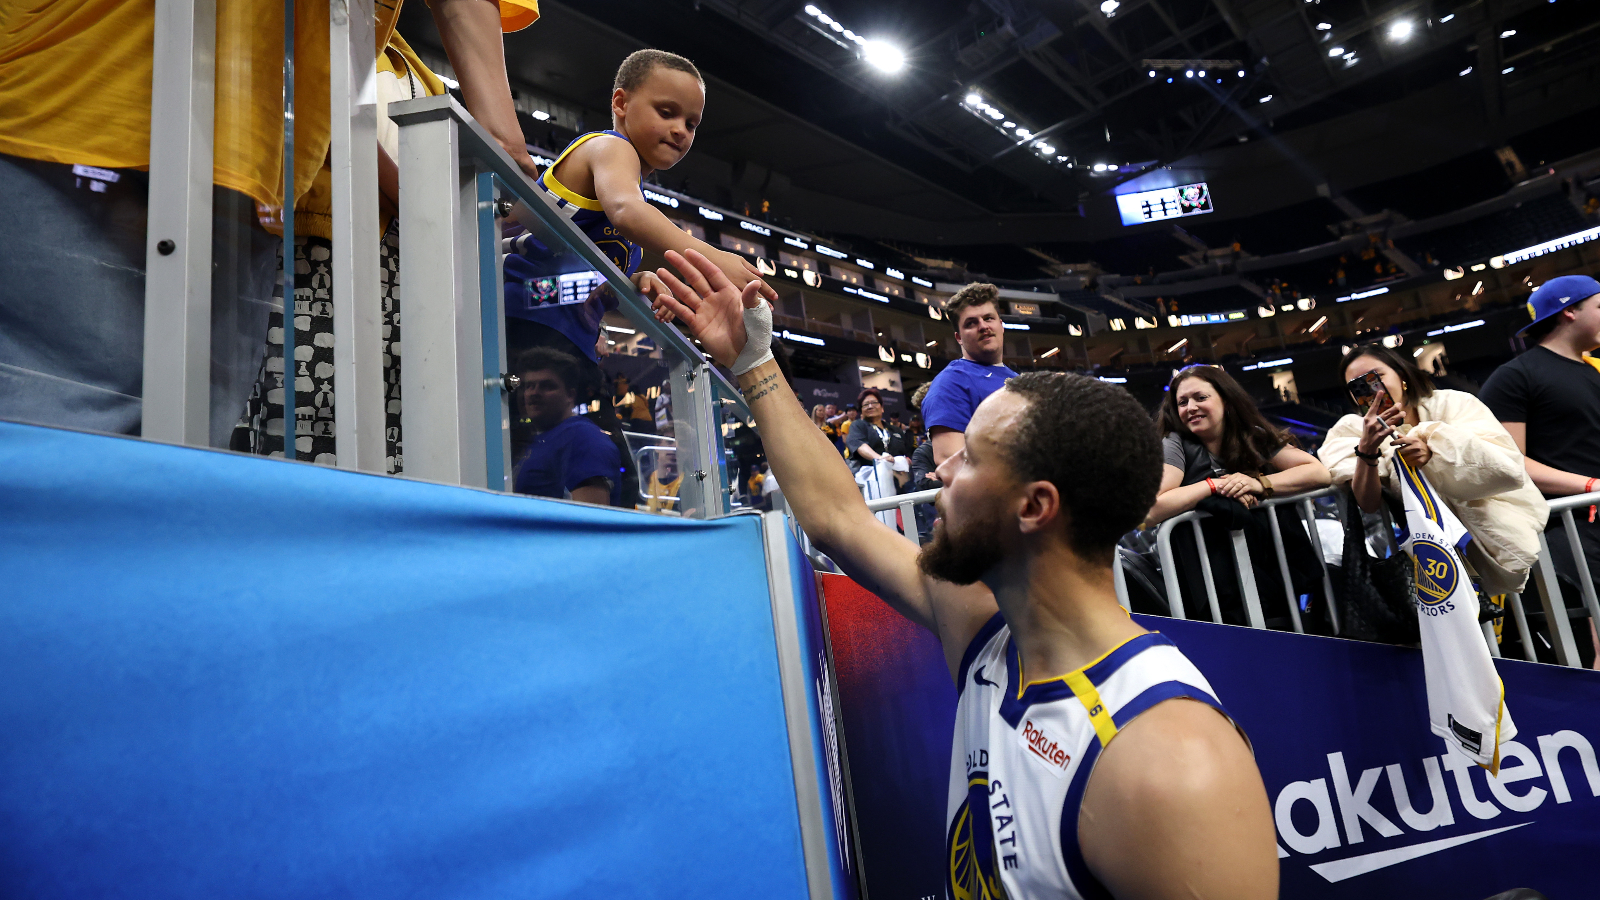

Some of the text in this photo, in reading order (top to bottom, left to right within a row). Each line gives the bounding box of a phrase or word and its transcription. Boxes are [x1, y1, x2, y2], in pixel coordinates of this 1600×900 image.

[740, 220, 772, 237] ORACLE
[1425, 558, 1448, 579] 30
[1089, 704, 1104, 717] 6
[1022, 720, 1071, 771] Rakuten
[1274, 729, 1600, 858] akuten
[987, 779, 1019, 871] STATE
